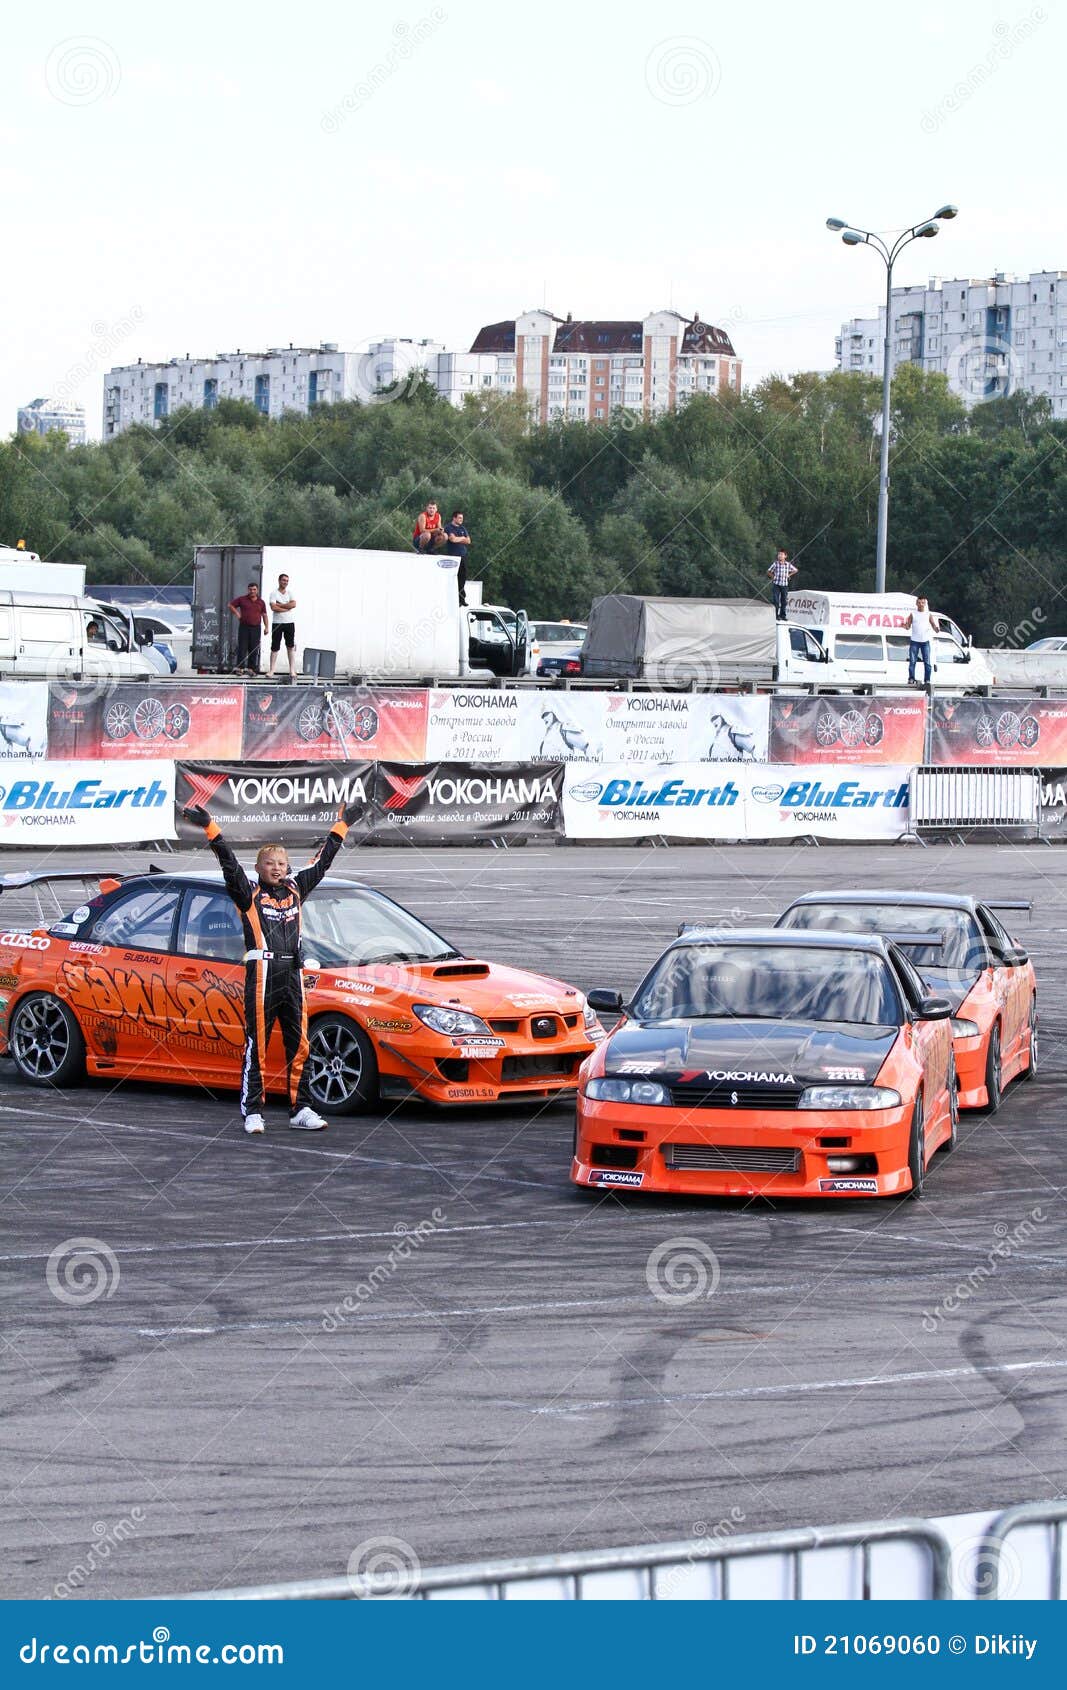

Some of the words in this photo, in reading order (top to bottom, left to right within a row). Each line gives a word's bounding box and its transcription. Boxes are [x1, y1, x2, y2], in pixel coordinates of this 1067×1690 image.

[202, 697, 238, 705] YOKOHAMA
[452, 695, 518, 709] YOKOHAMA
[626, 699, 689, 712] YOKOHAMA
[430, 715, 482, 729] Открытие
[485, 715, 517, 726] завода
[605, 718, 656, 732] Открытие
[658, 718, 688, 730] завода
[460, 732, 493, 743] России
[634, 735, 665, 745] России
[453, 748, 476, 759] 2011
[627, 750, 649, 760] 2011
[2, 780, 168, 810] BluEarth
[228, 778, 367, 804] YOKOHAMA
[426, 779, 558, 804] YOKOHAMA
[598, 779, 739, 807] BluEarth
[779, 781, 910, 808] BluEarth
[20, 815, 76, 826] YOKOHAMA
[242, 811, 271, 823] завода
[279, 812, 309, 823] России
[319, 811, 339, 822] 2011
[387, 812, 435, 826] Открытие
[437, 811, 465, 822] завода
[473, 811, 503, 823] России
[511, 811, 530, 821] 2011
[531, 810, 553, 823] году!
[612, 811, 660, 821] YOKOHAMA
[793, 812, 837, 822] YOKOHAMA
[1, 932, 51, 951] CUSCO
[123, 952, 164, 965] SUBARU
[335, 978, 375, 994] YOKOHAMA
[465, 1038, 504, 1046] YOKOHAMA
[706, 1071, 795, 1084] YOKOHAMA
[448, 1089, 475, 1097] CUSCO
[602, 1173, 641, 1185] YOKOHAMA
[834, 1182, 877, 1190] YOKOHAMA
